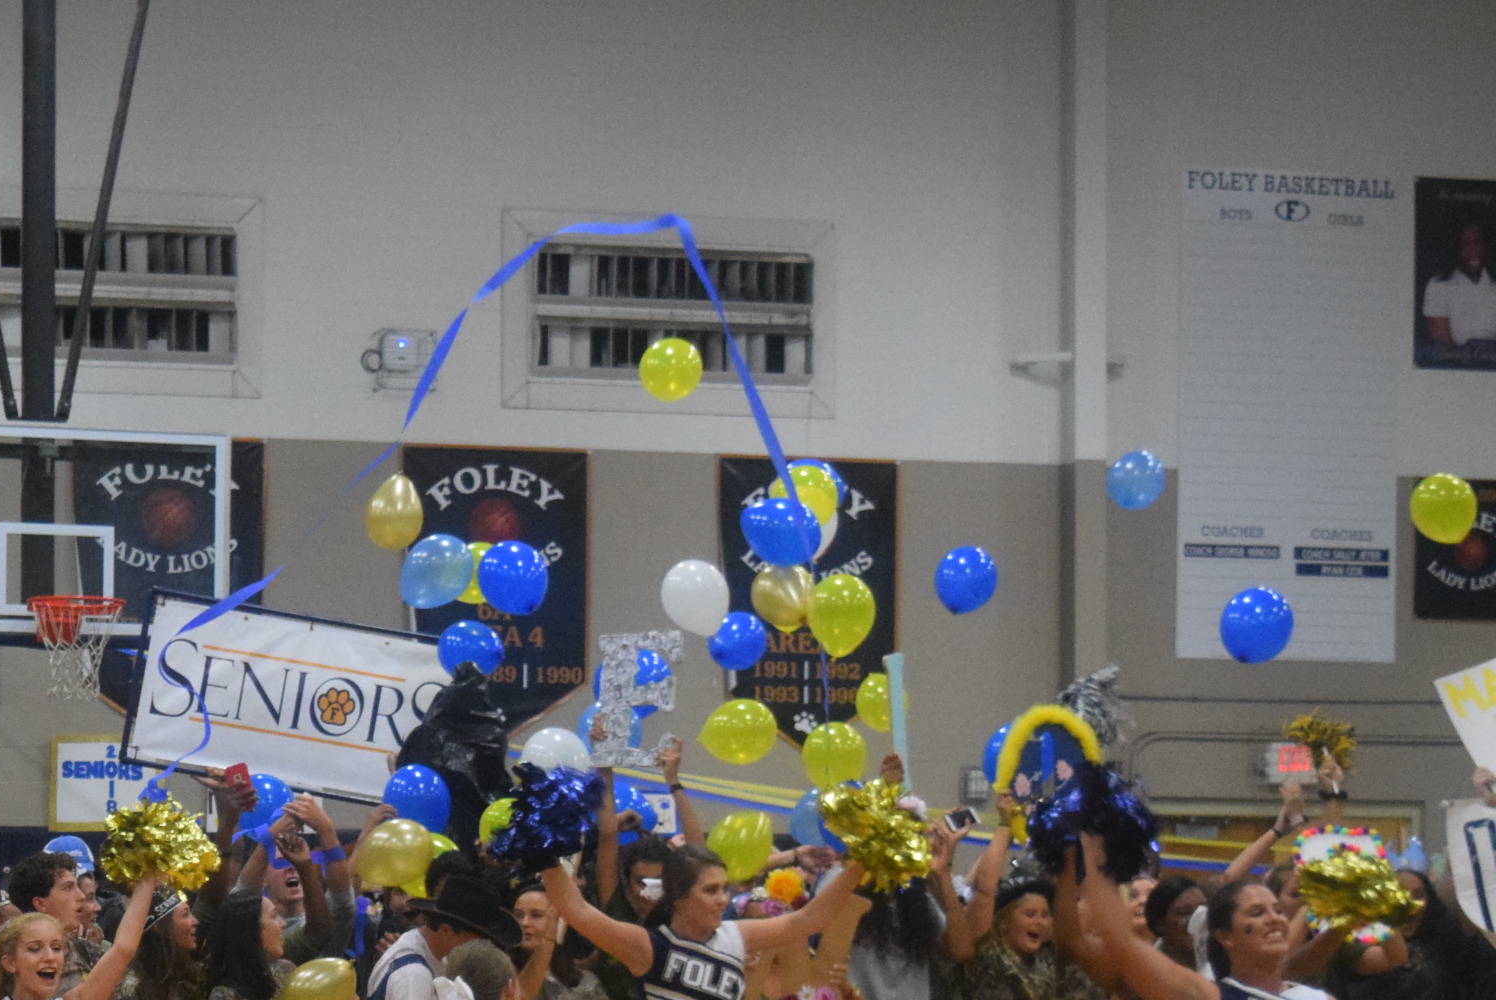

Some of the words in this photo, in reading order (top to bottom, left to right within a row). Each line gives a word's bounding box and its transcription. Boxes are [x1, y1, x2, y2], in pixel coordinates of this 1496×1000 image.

[1187, 170, 1257, 192] FOLEY
[1263, 174, 1395, 199] BASKETBALL
[426, 464, 565, 511] FOLEY
[1201, 525, 1264, 539] COACHES
[1311, 528, 1373, 542] COACHES
[1427, 559, 1466, 590] LADY
[527, 625, 544, 648] 4
[766, 632, 822, 654] ARE
[536, 666, 583, 684] 1990
[62, 760, 144, 781] SENIORS
